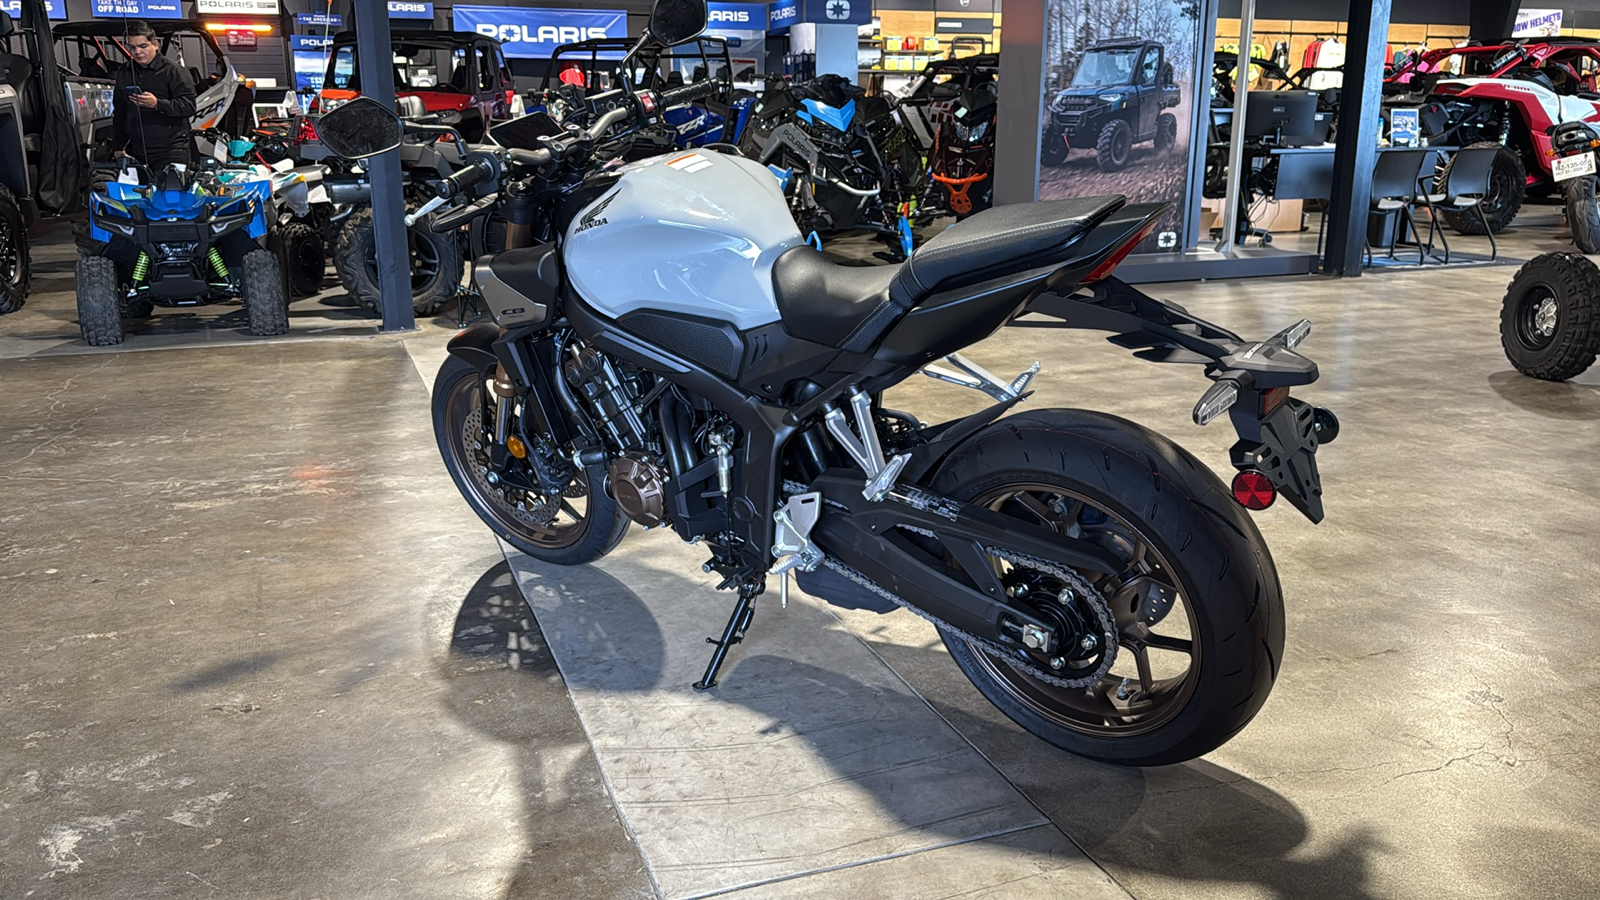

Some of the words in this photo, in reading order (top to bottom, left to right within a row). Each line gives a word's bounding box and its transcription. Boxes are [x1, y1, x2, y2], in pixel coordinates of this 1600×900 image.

[0, 1, 53, 11] LAS
[770, 6, 796, 21] POLARIS
[708, 11, 749, 22] ARIS
[1530, 12, 1561, 29] HELMETS
[476, 24, 607, 43] POLARIS
[189, 97, 226, 124] RZR
[783, 129, 811, 158] POLARIS
[574, 218, 608, 234] HONDA
